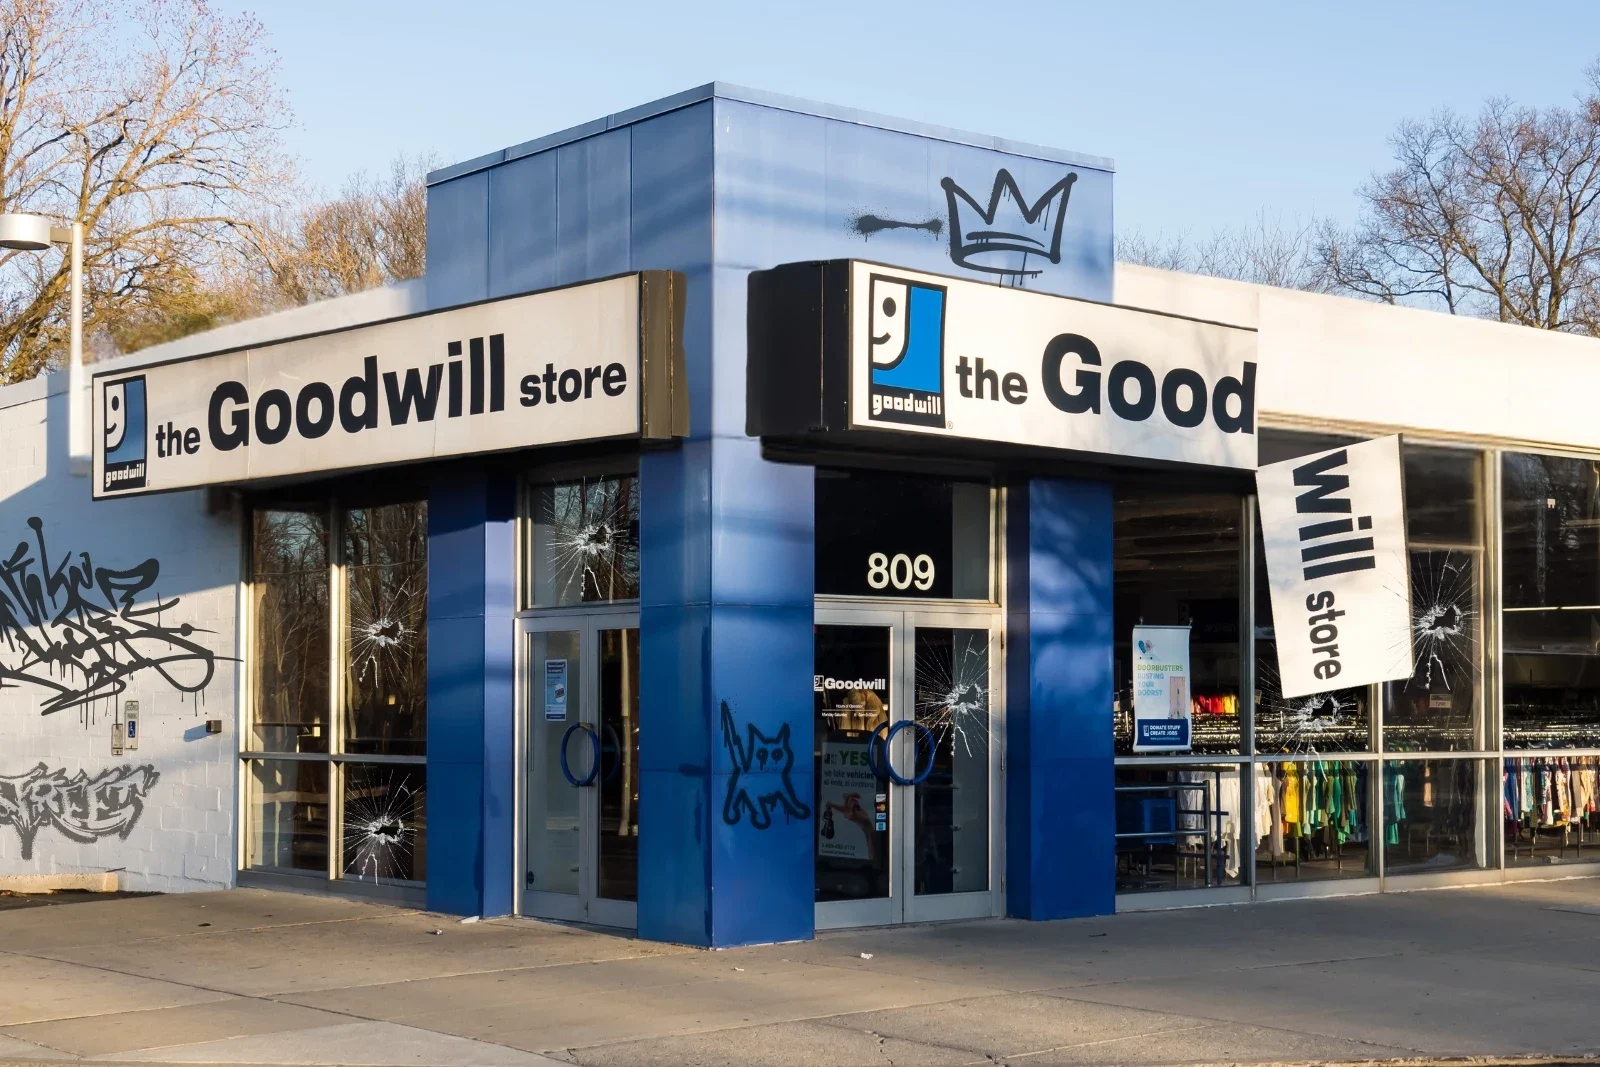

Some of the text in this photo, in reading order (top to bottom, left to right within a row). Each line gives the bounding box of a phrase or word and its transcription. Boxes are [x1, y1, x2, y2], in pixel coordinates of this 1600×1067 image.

[955, 333, 1256, 434] the Good
[155, 333, 627, 459] the Goodwill store
[872, 392, 942, 415] goodwill
[105, 463, 145, 488] goodwill
[867, 553, 935, 592] 809
[1292, 449, 1376, 680] will store
[1137, 664, 1184, 672] DOORBUSTERS
[824, 677, 886, 690] Goodwill
[839, 750, 869, 766] YES
[833, 769, 846, 778] take
[846, 769, 875, 780] vehicles
